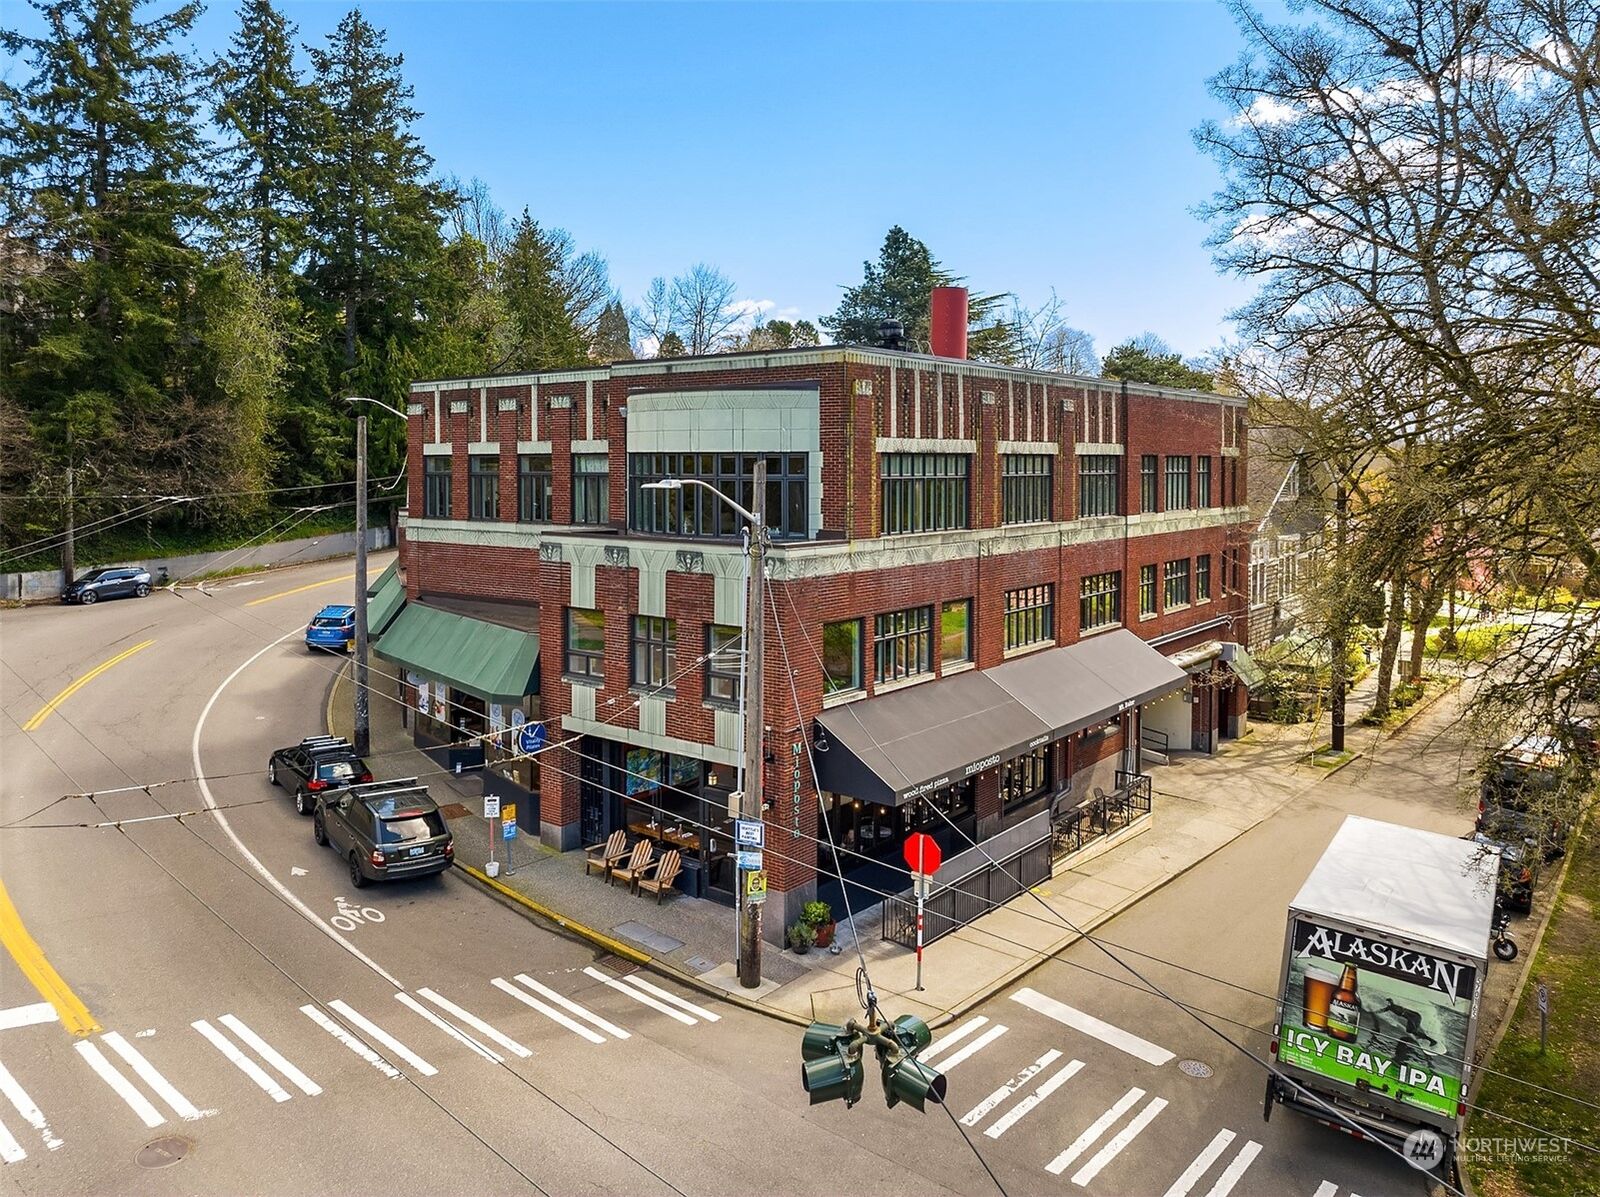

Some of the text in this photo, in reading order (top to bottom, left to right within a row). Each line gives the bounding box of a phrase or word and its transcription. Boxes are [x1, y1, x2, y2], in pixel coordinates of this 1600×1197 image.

[793, 742, 802, 838] Mioposto
[903, 777, 950, 799] wood fired pizza
[965, 754, 1001, 775] mioposto
[1295, 926, 1465, 1006] ALASKAN
[1286, 1029, 1446, 1097] ICY BAY IPA
